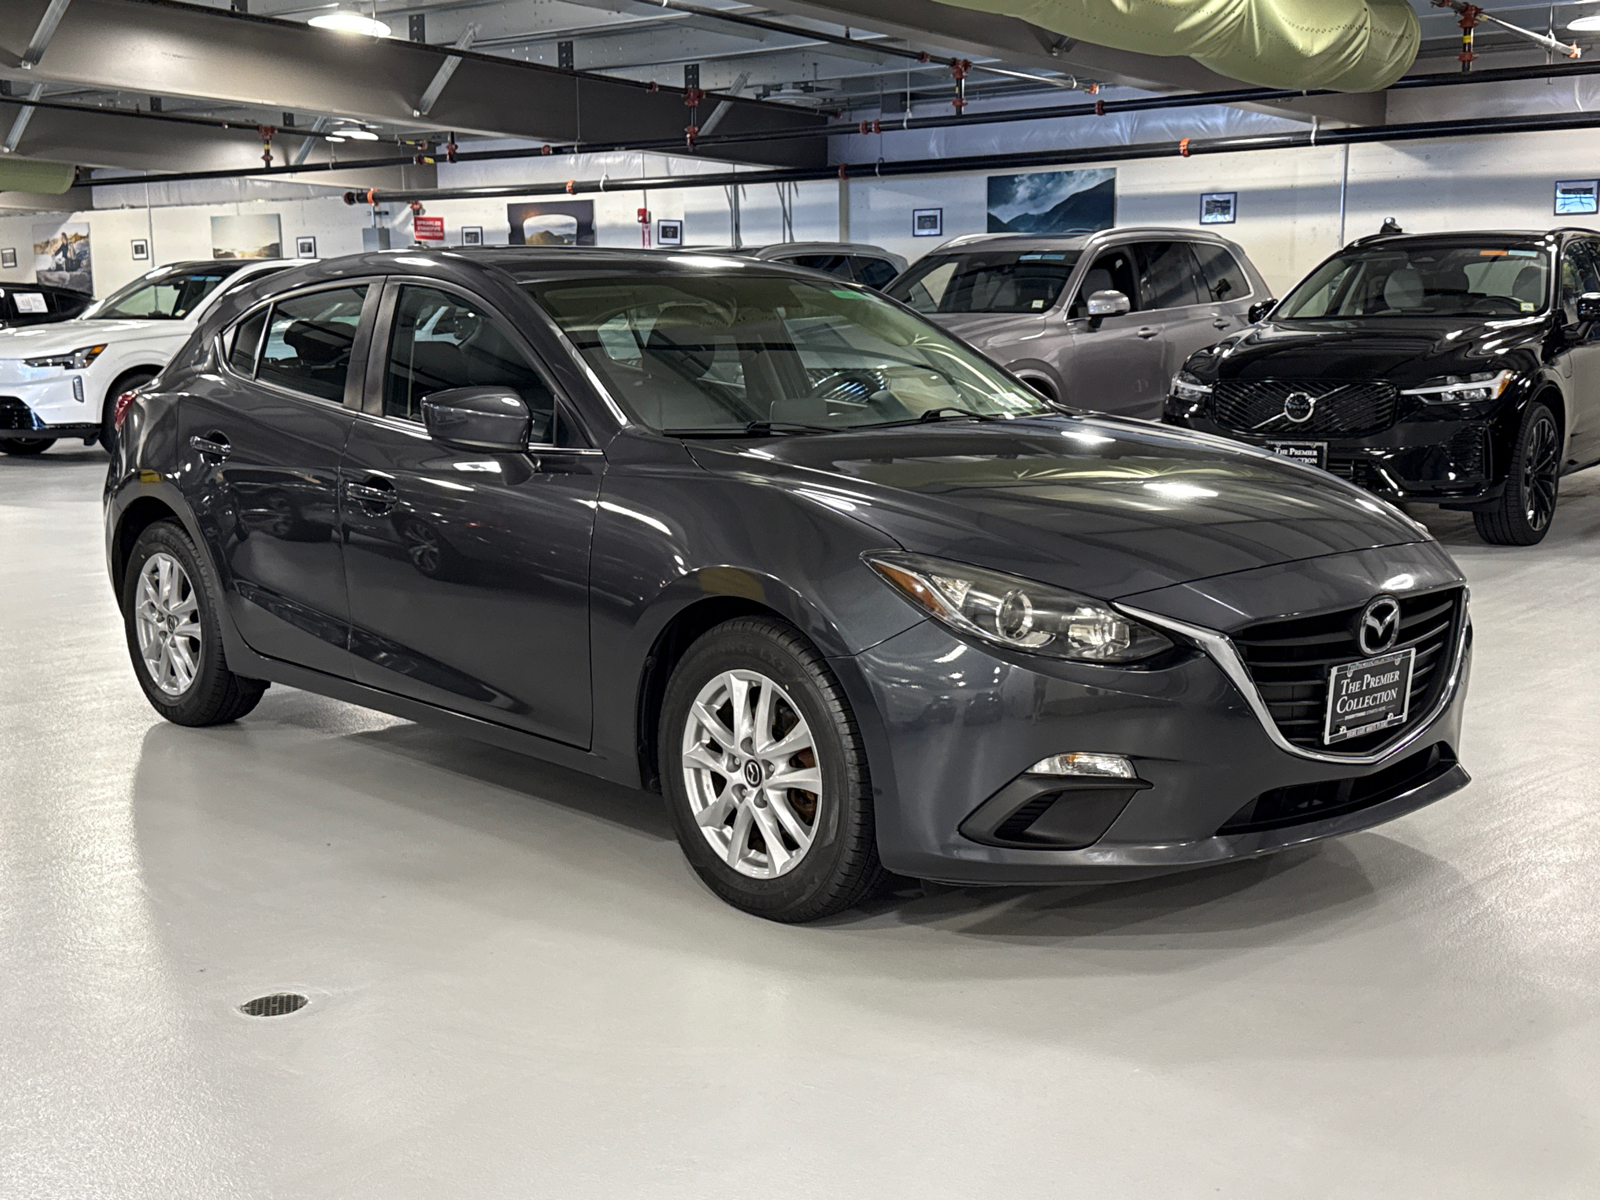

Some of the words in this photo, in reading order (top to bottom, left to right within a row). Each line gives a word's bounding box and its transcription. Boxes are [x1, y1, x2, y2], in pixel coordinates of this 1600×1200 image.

[1289, 447, 1318, 456] PREMIER
[1341, 678, 1361, 695] THE
[1362, 670, 1400, 690] PREMIER
[1336, 687, 1398, 714] COLLECTION
